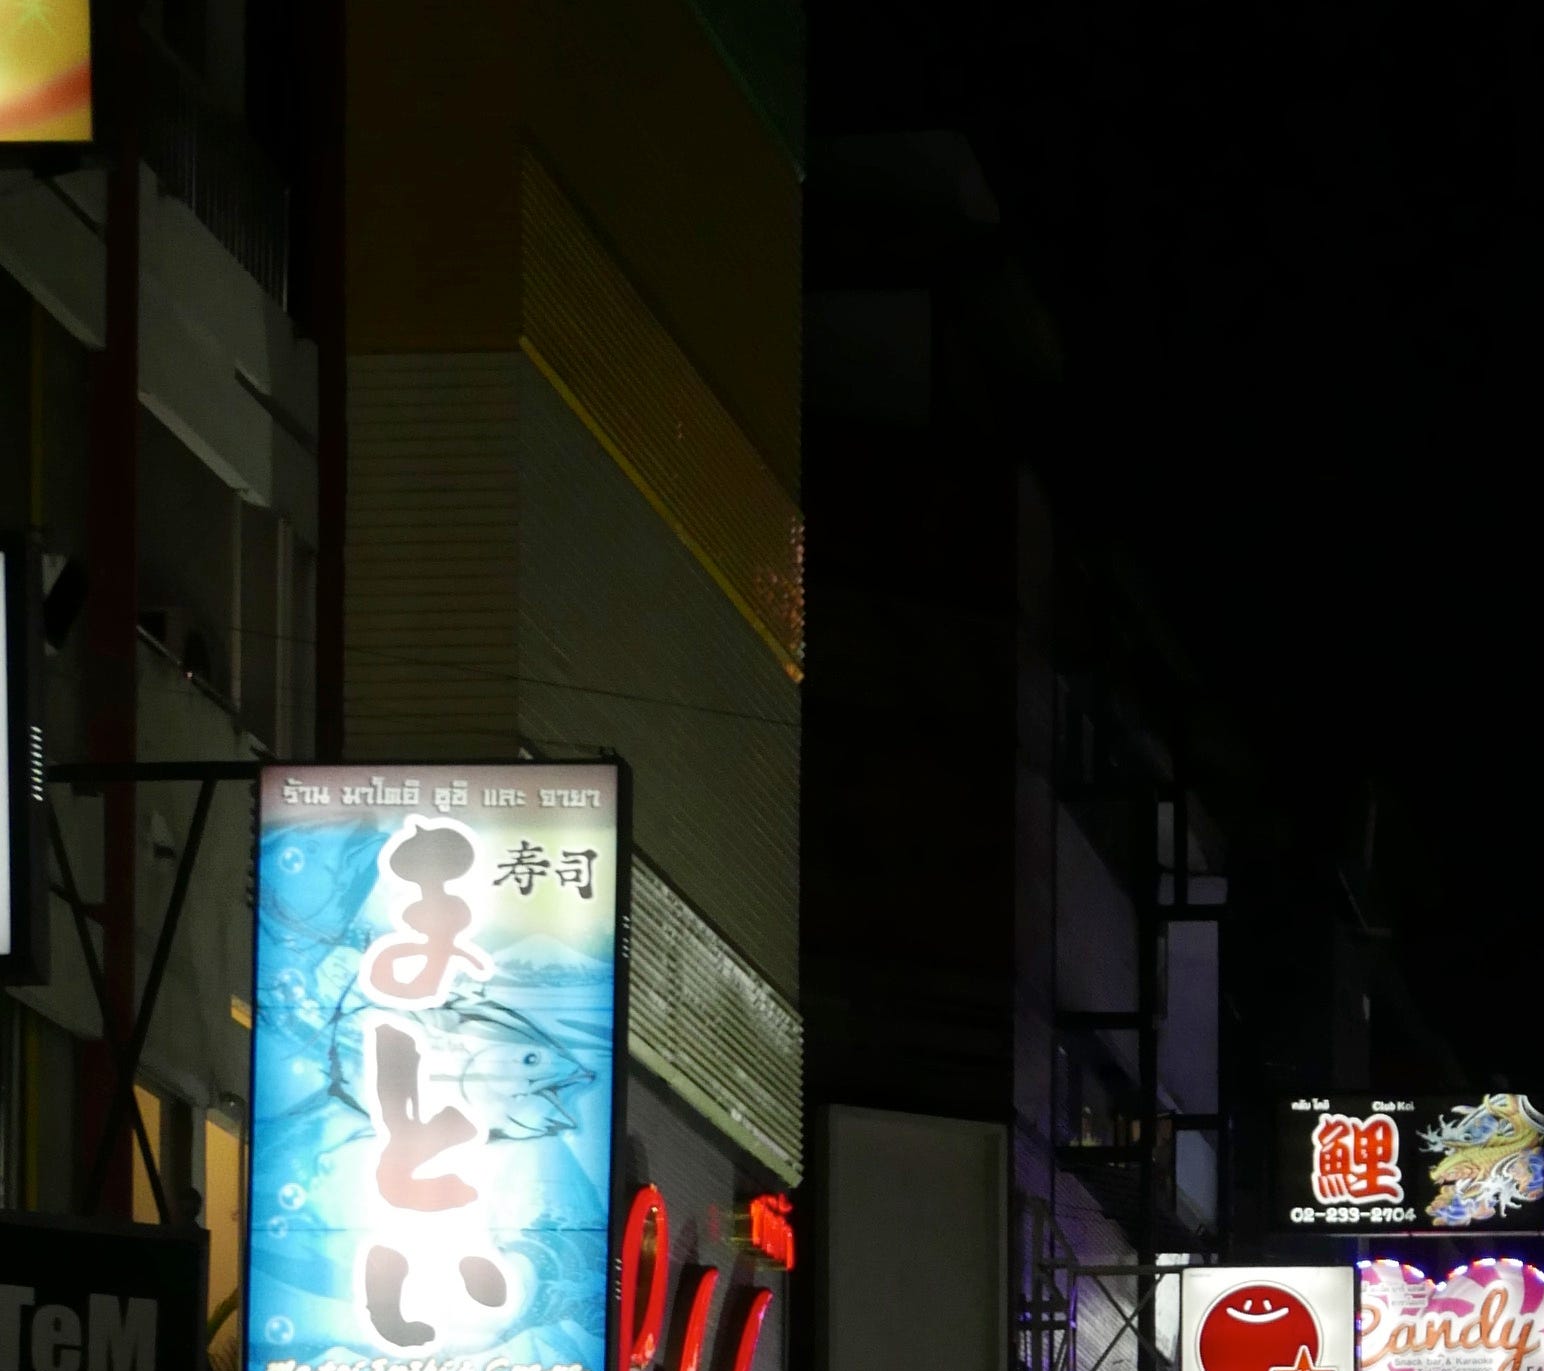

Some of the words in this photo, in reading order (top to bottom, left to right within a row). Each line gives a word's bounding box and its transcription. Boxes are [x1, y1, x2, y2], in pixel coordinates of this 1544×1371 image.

[493, 840, 598, 899] 寿司
[364, 822, 508, 1350] まとい
[1371, 1100, 1396, 1112] Club
[1397, 1101, 1415, 1112] Koi
[1313, 1114, 1404, 1204] 鯉
[1289, 1207, 1418, 1224] 02-233-2704
[1394, 1356, 1423, 1368] Snack
[1455, 1356, 1494, 1367] Karaoke
